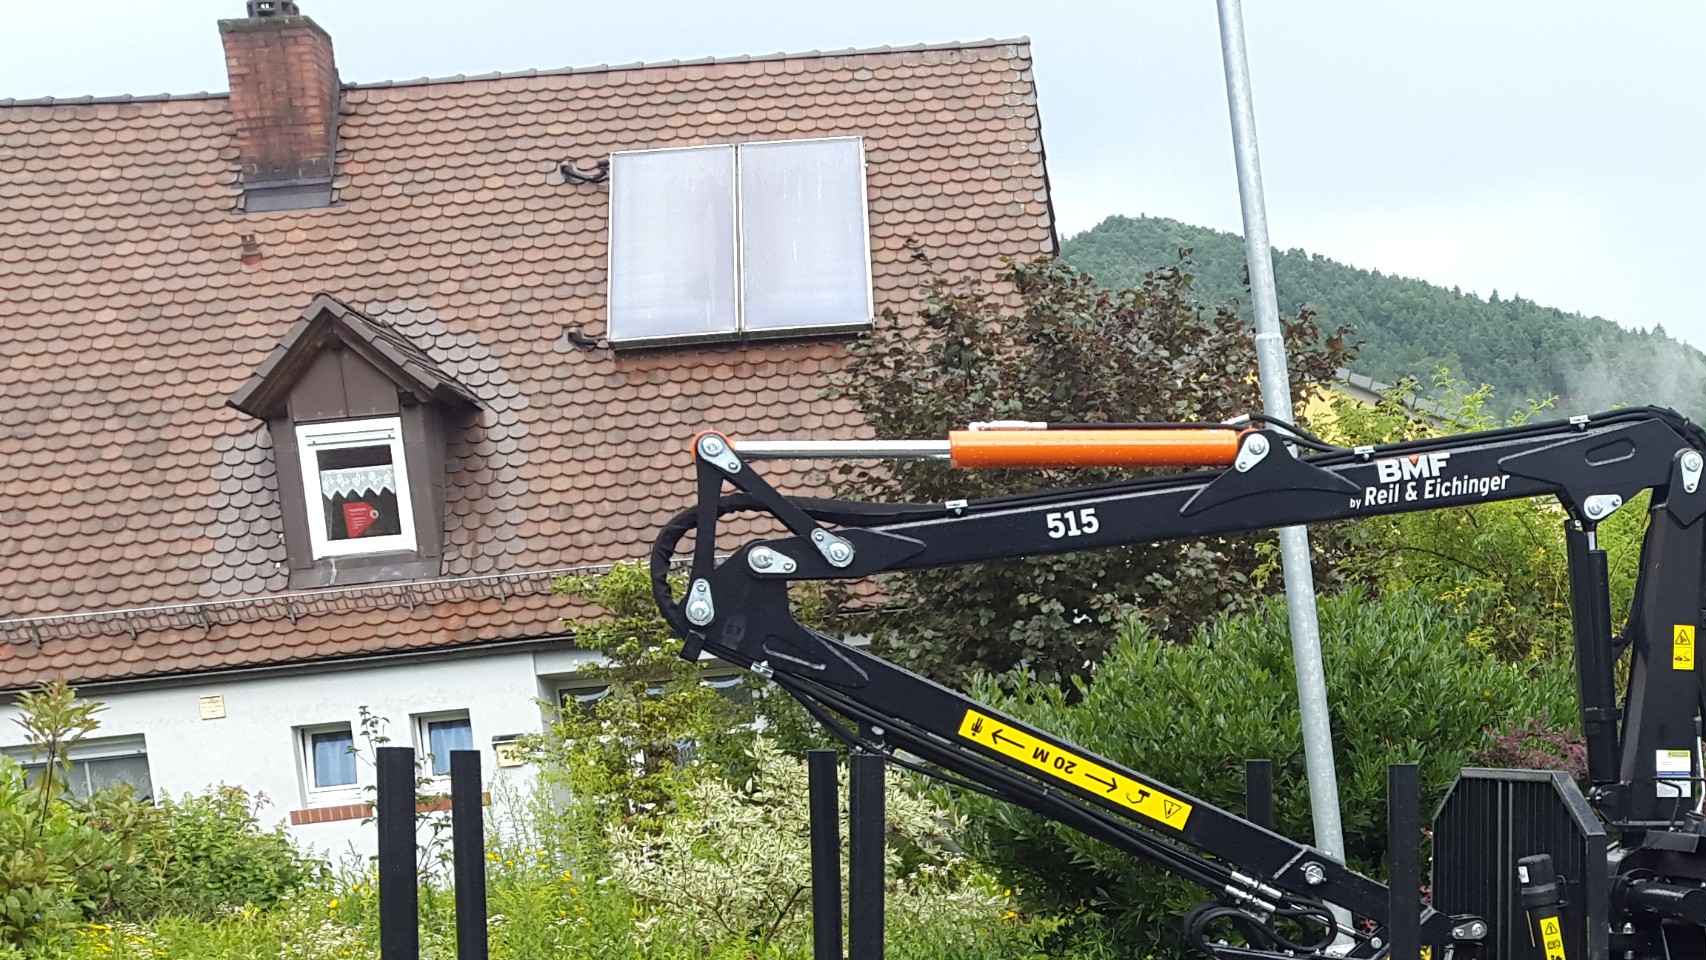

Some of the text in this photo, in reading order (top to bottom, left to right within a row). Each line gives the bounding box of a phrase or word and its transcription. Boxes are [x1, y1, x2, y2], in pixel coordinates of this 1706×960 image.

[1376, 452, 1450, 484] BMF
[1350, 474, 1510, 510] by Reil & Eichinger
[1046, 508, 1099, 538] 515
[1032, 747, 1077, 774] 20 M
